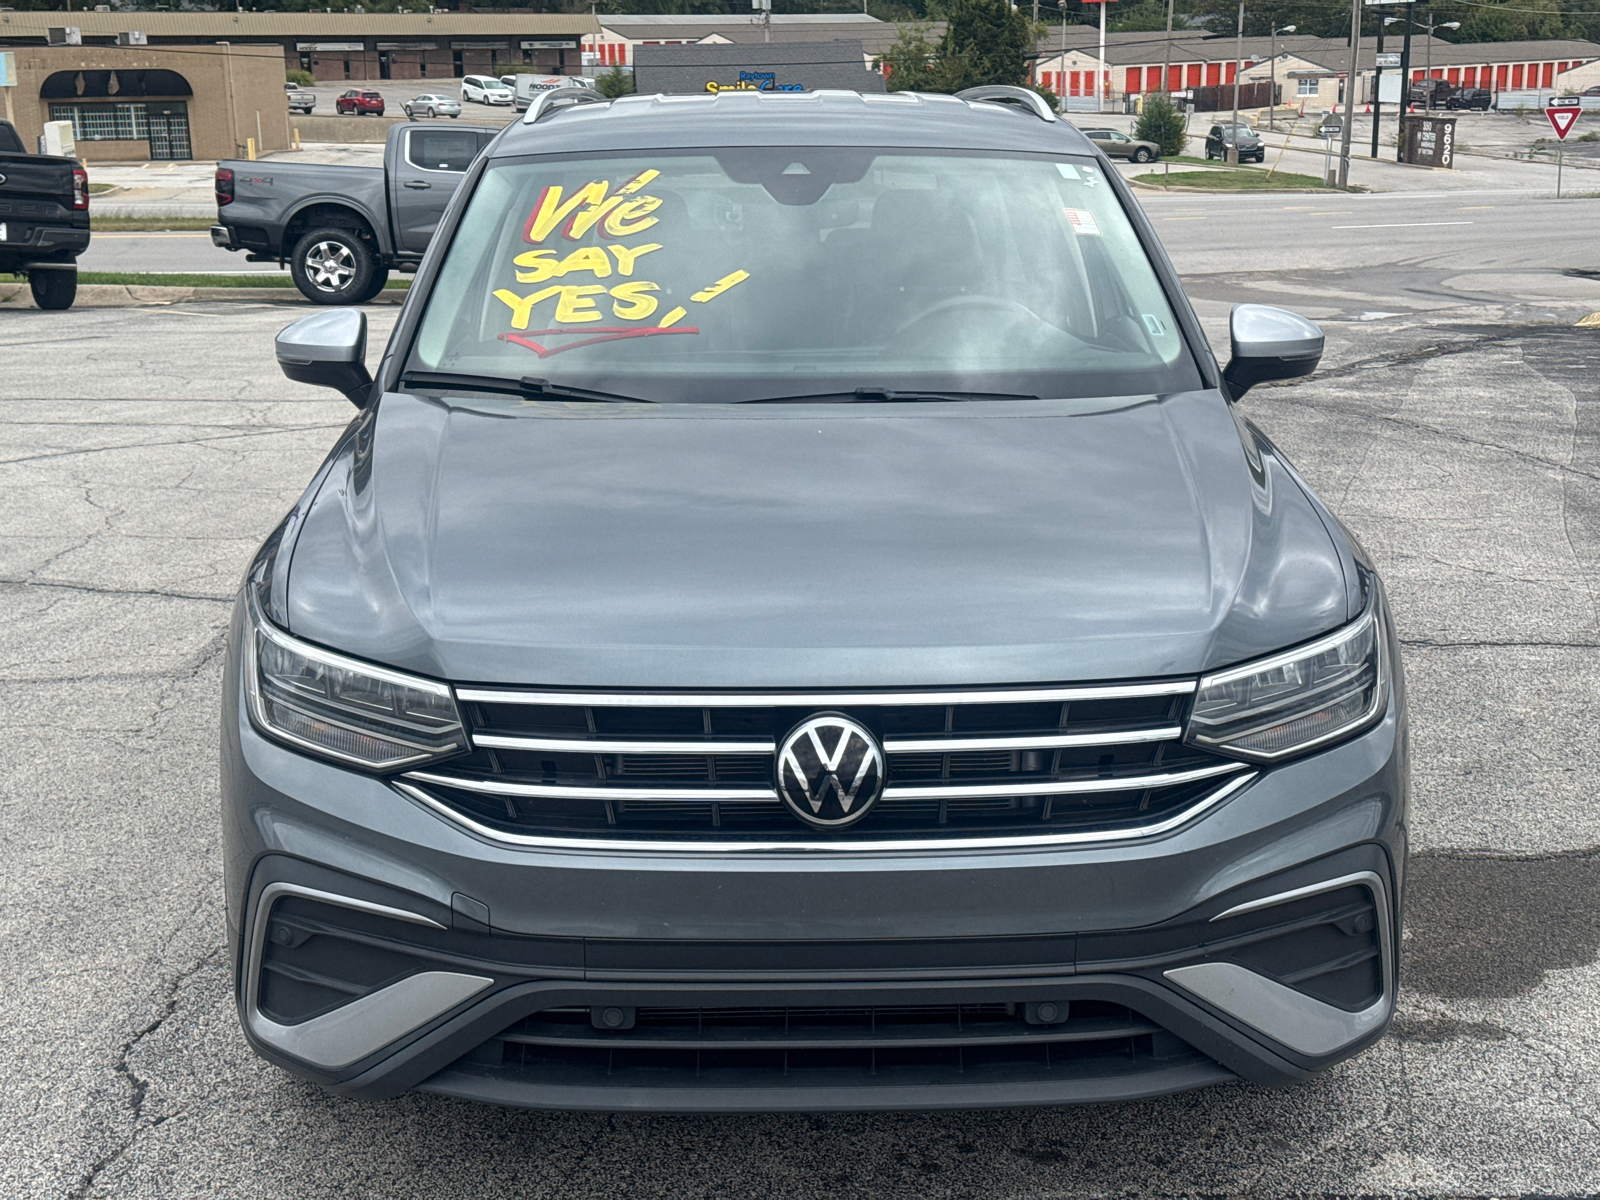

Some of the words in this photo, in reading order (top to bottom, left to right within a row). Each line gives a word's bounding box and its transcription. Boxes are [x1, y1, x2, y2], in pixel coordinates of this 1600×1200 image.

[740, 71, 775, 81] Raytown
[760, 80, 804, 92] Cre
[1441, 123, 1452, 165] 9620
[521, 168, 663, 245] We
[513, 243, 663, 284] SAY
